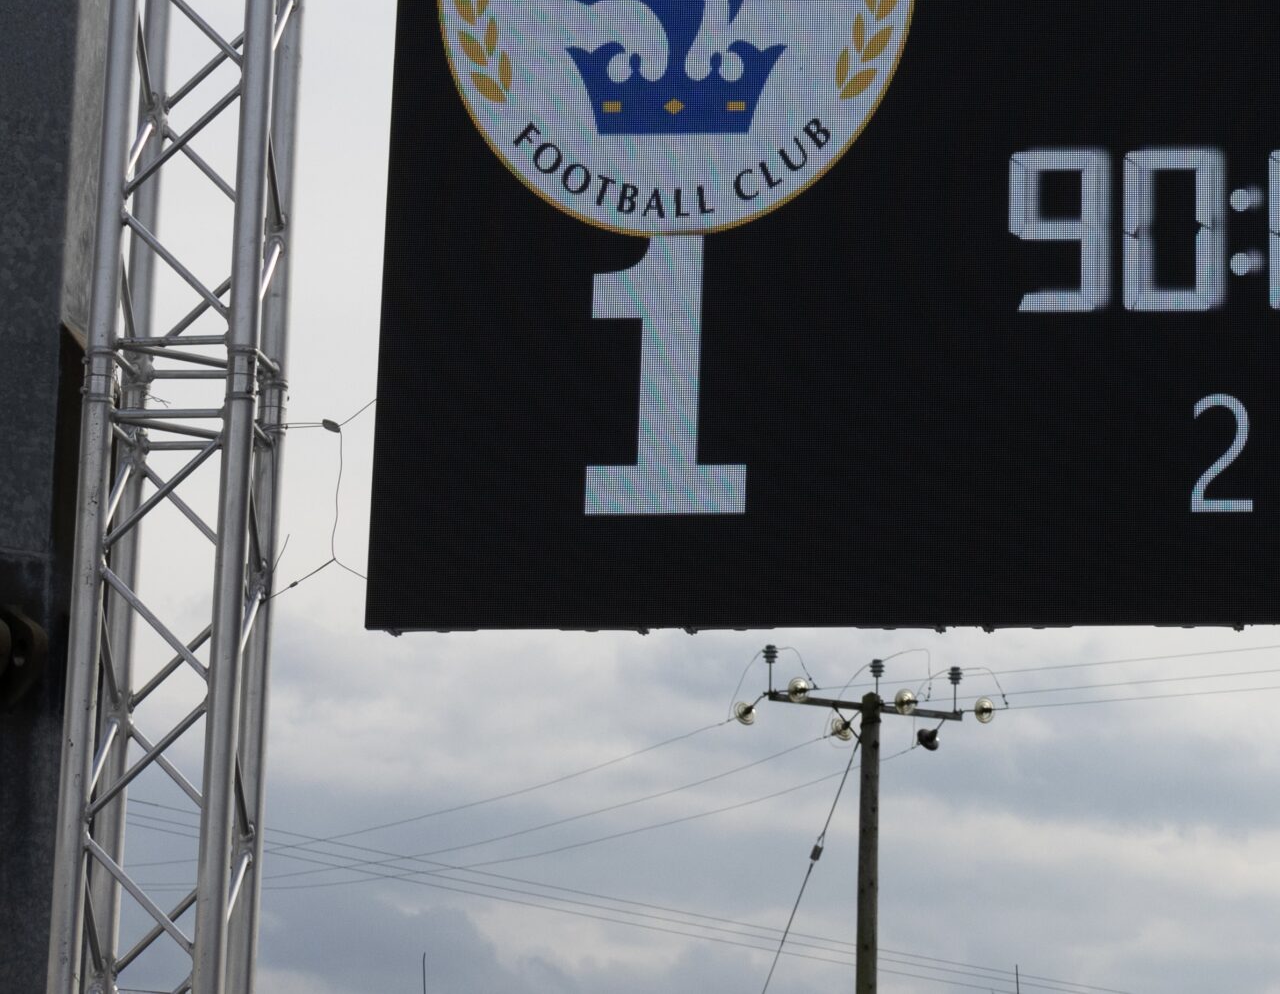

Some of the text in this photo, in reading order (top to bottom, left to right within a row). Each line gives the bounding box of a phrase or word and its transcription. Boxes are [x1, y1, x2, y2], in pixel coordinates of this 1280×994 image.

[513, 117, 831, 220] FOOTBALL CLUB
[585, 235, 746, 517] 1
[1190, 393, 1254, 514] 2
